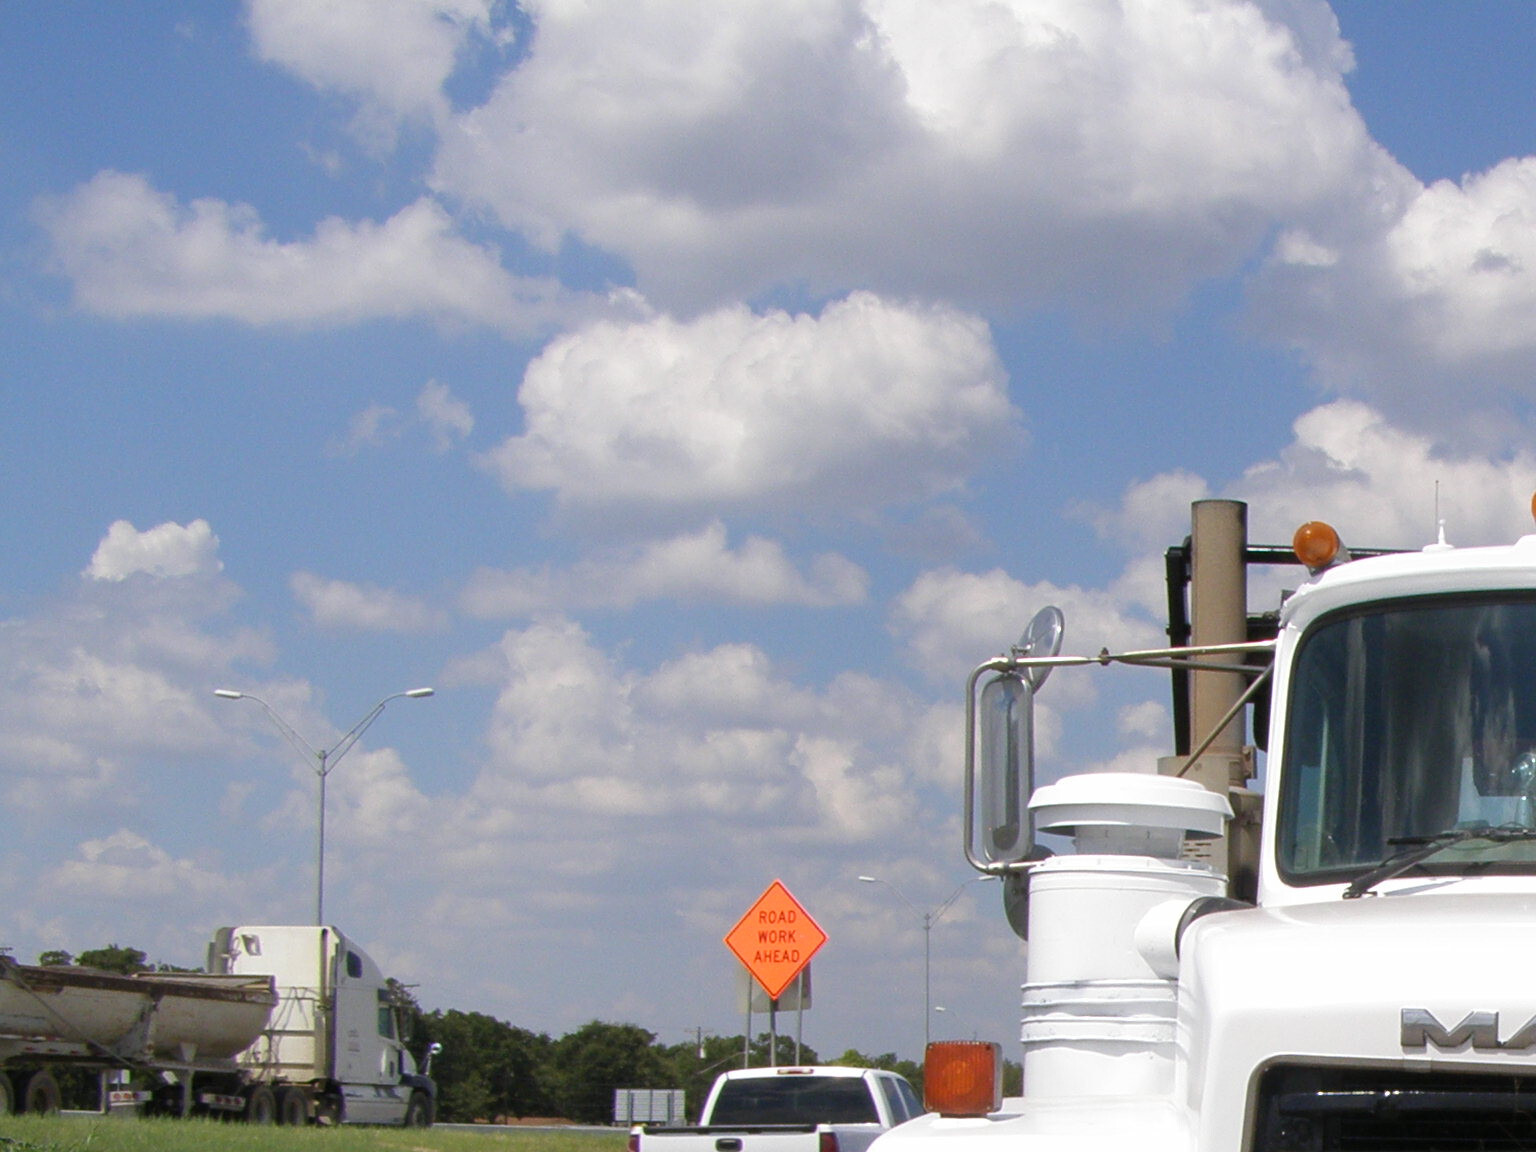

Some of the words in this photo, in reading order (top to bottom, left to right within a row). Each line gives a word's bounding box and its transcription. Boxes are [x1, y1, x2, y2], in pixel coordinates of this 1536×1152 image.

[758, 910, 797, 924] ROAD
[758, 930, 797, 944] WORK
[753, 950, 800, 963] AHEAD
